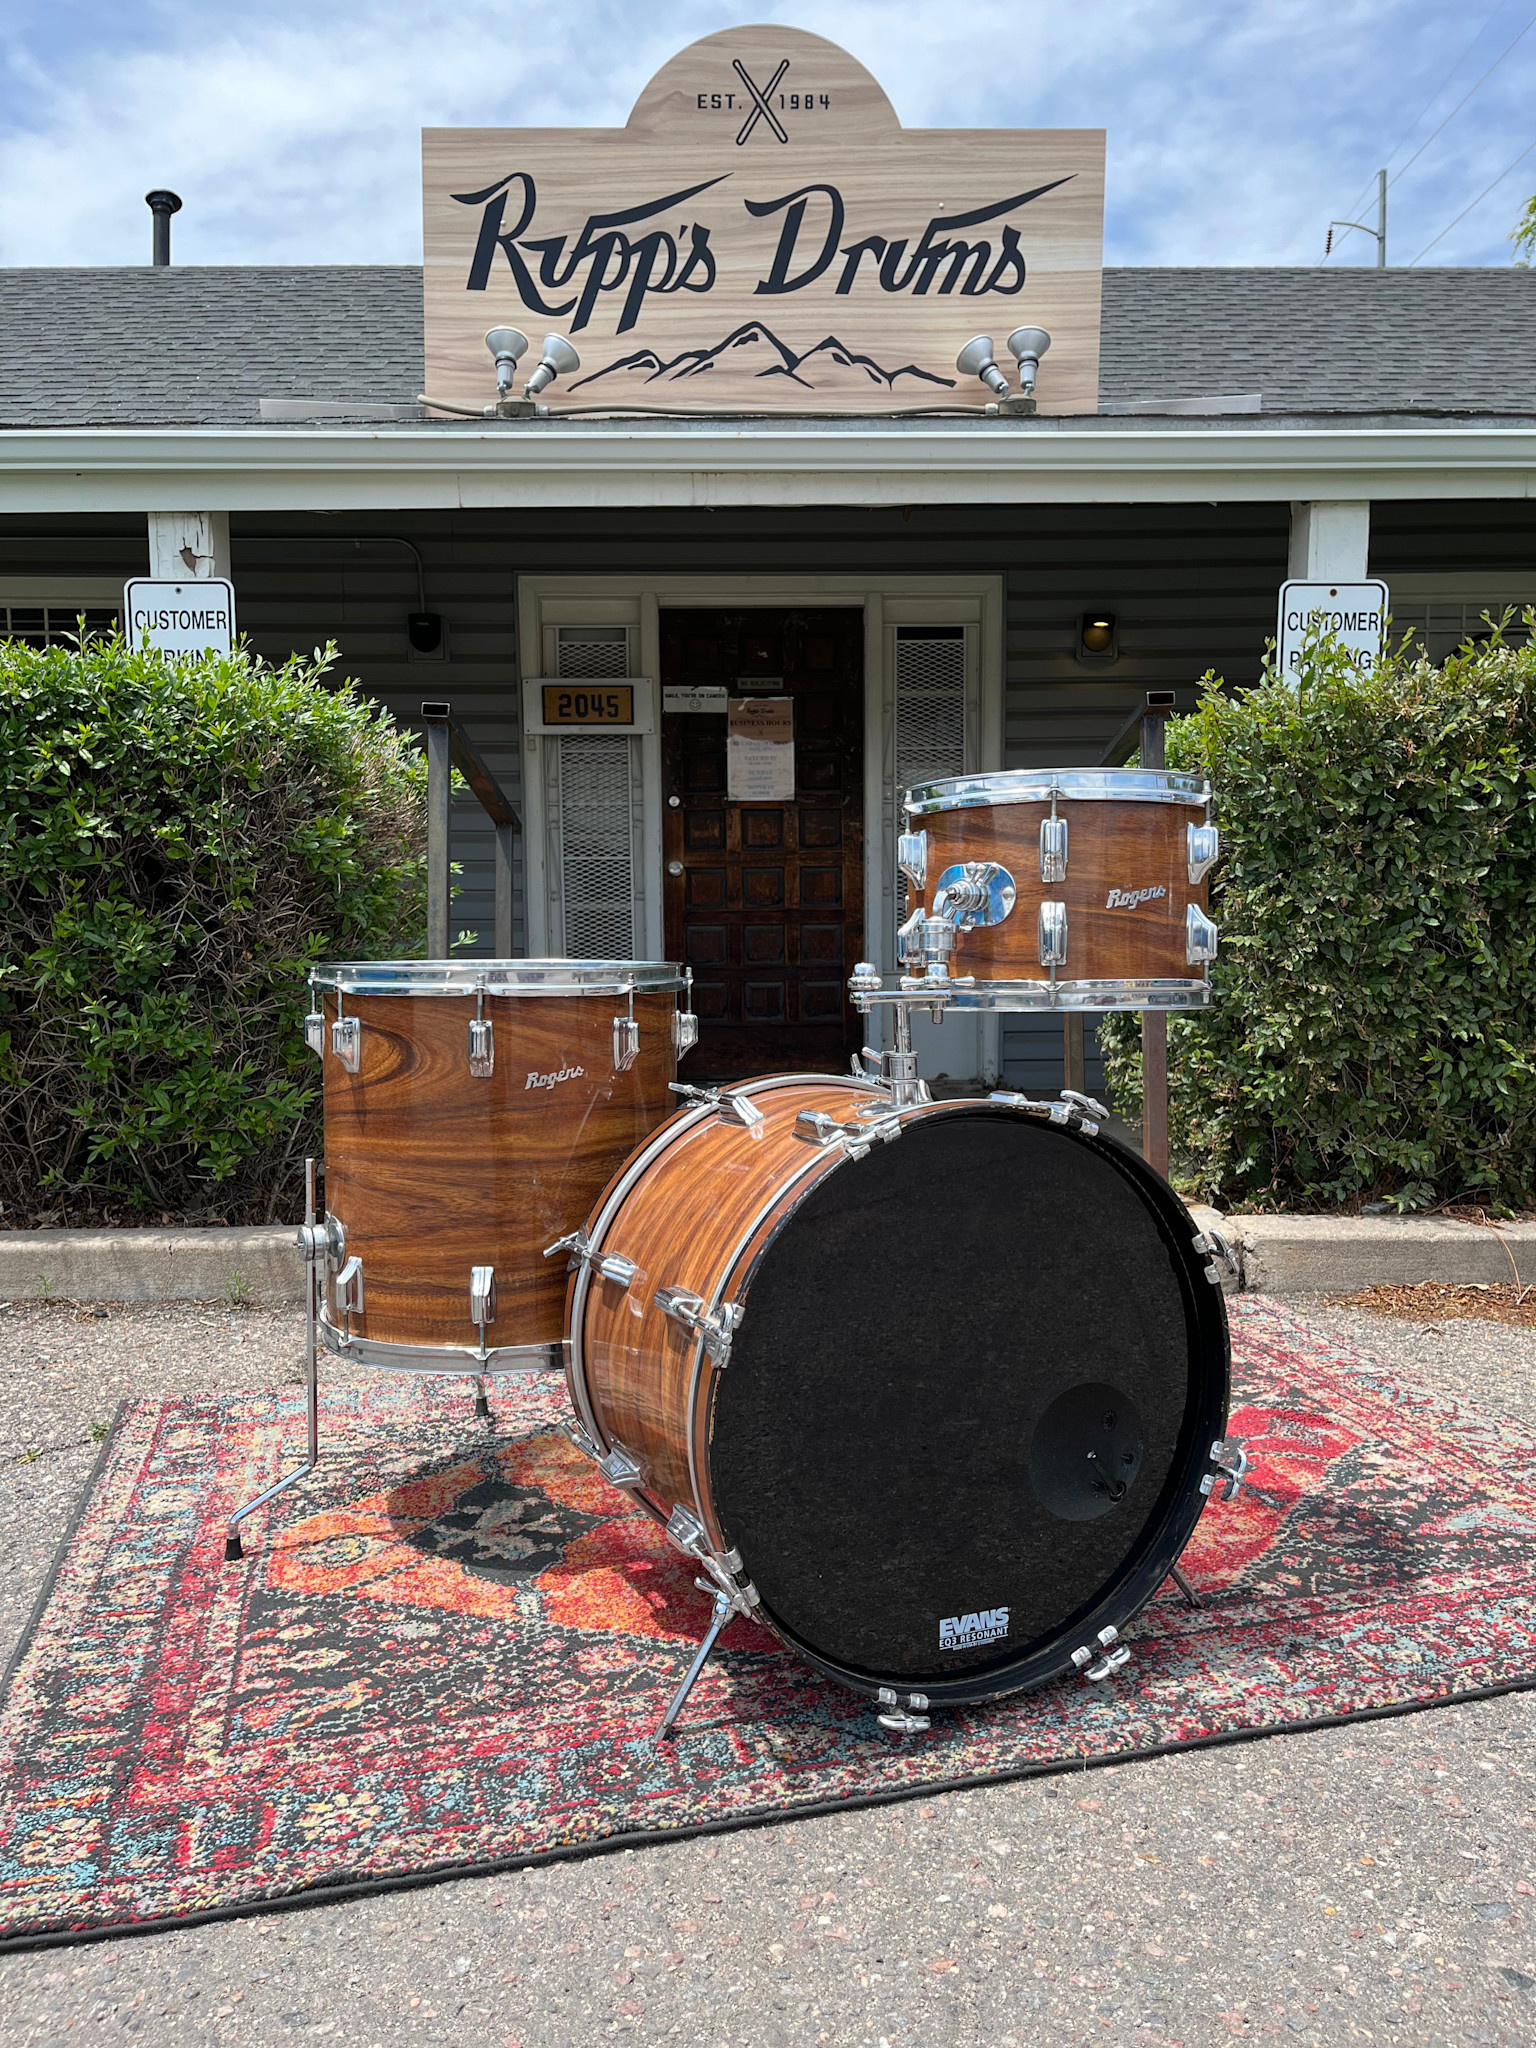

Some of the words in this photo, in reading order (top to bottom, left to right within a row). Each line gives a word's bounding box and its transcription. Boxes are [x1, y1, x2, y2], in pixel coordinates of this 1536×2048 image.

[697, 93, 743, 110] EST.
[779, 94, 831, 110] 1984
[449, 172, 735, 335] Rupp's
[744, 173, 1079, 296] Drums
[135, 610, 227, 630] CUSTOMER
[558, 694, 619, 718] 2045
[1106, 885, 1166, 910] Rogers
[525, 1066, 584, 1090] Rogers
[939, 1607, 1010, 1638] EVANS
[939, 1637, 957, 1648] EQ3
[960, 1626, 1009, 1643] RESONANT
